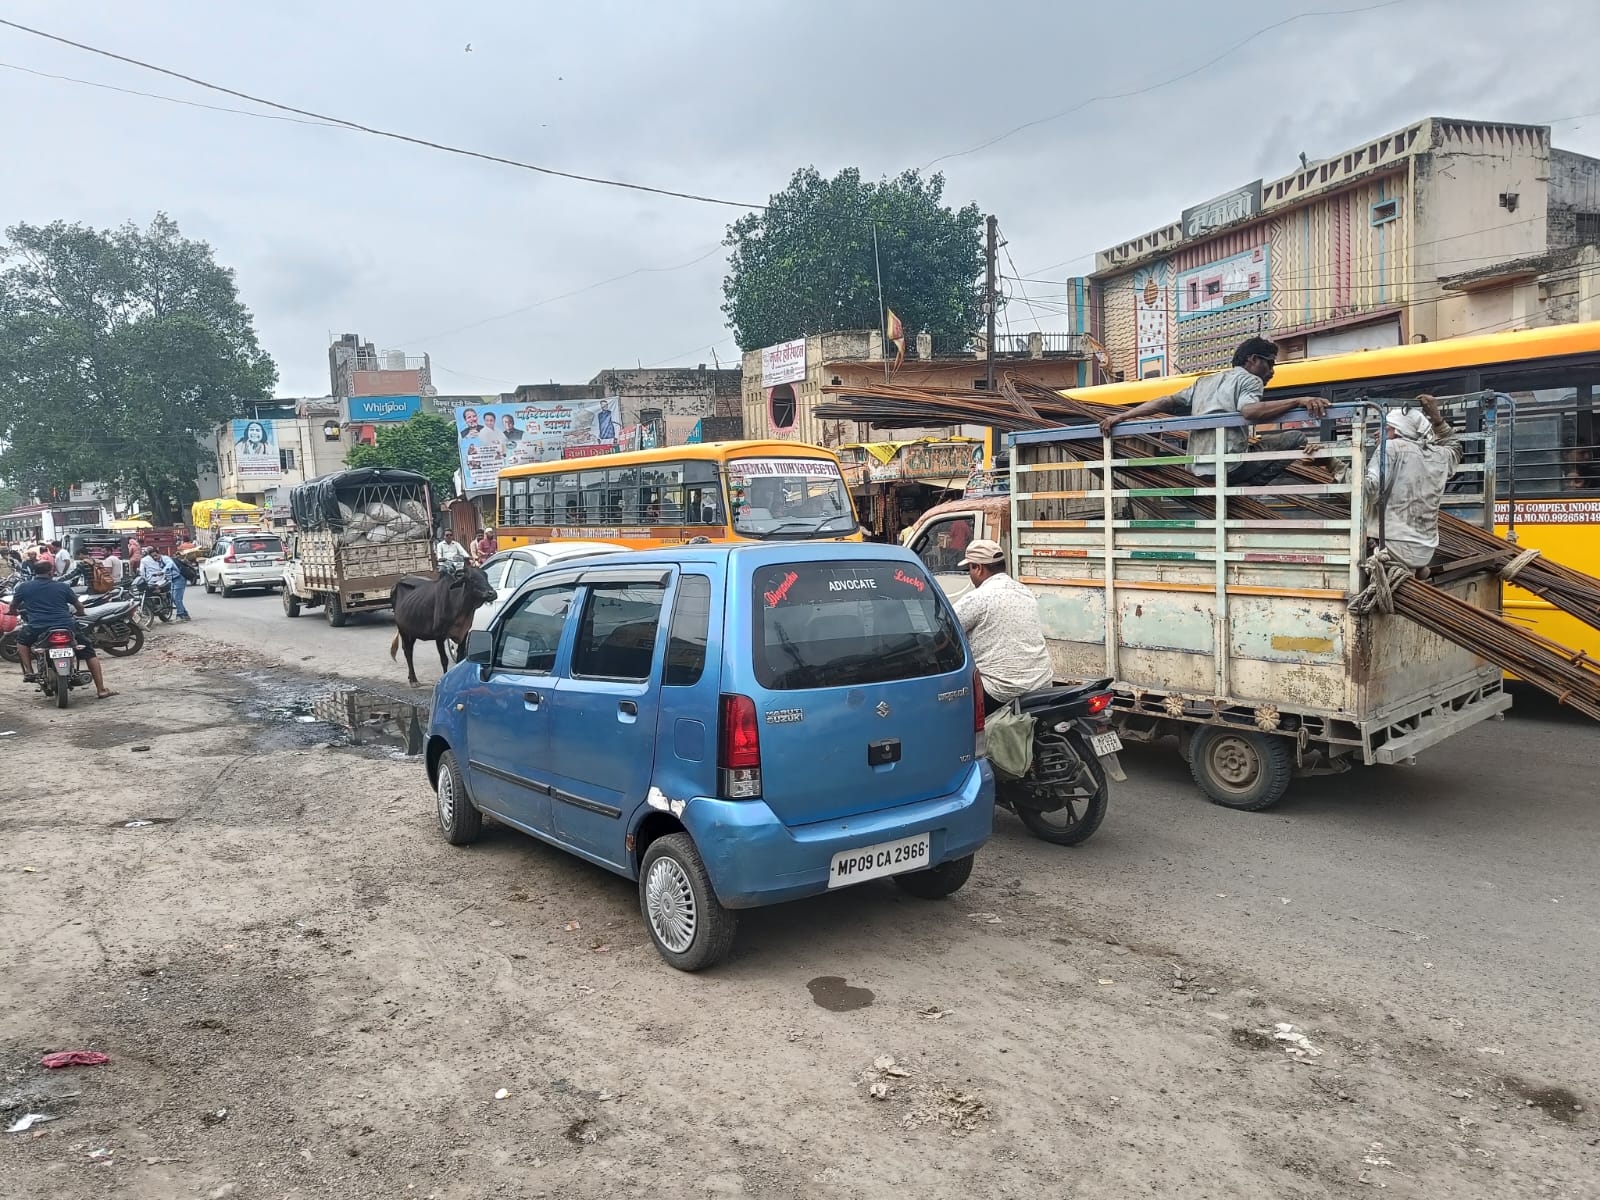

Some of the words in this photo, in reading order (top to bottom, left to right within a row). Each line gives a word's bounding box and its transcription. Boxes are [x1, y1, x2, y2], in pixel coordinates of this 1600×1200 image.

[362, 400, 407, 416] Whirlpool
[828, 578, 878, 592] ADVOCATE
[893, 568, 925, 592] Lucky
[766, 713, 804, 724] SUZUKI
[837, 854, 874, 876] MP09
[876, 850, 892, 868] CA
[894, 841, 925, 863] 2966
